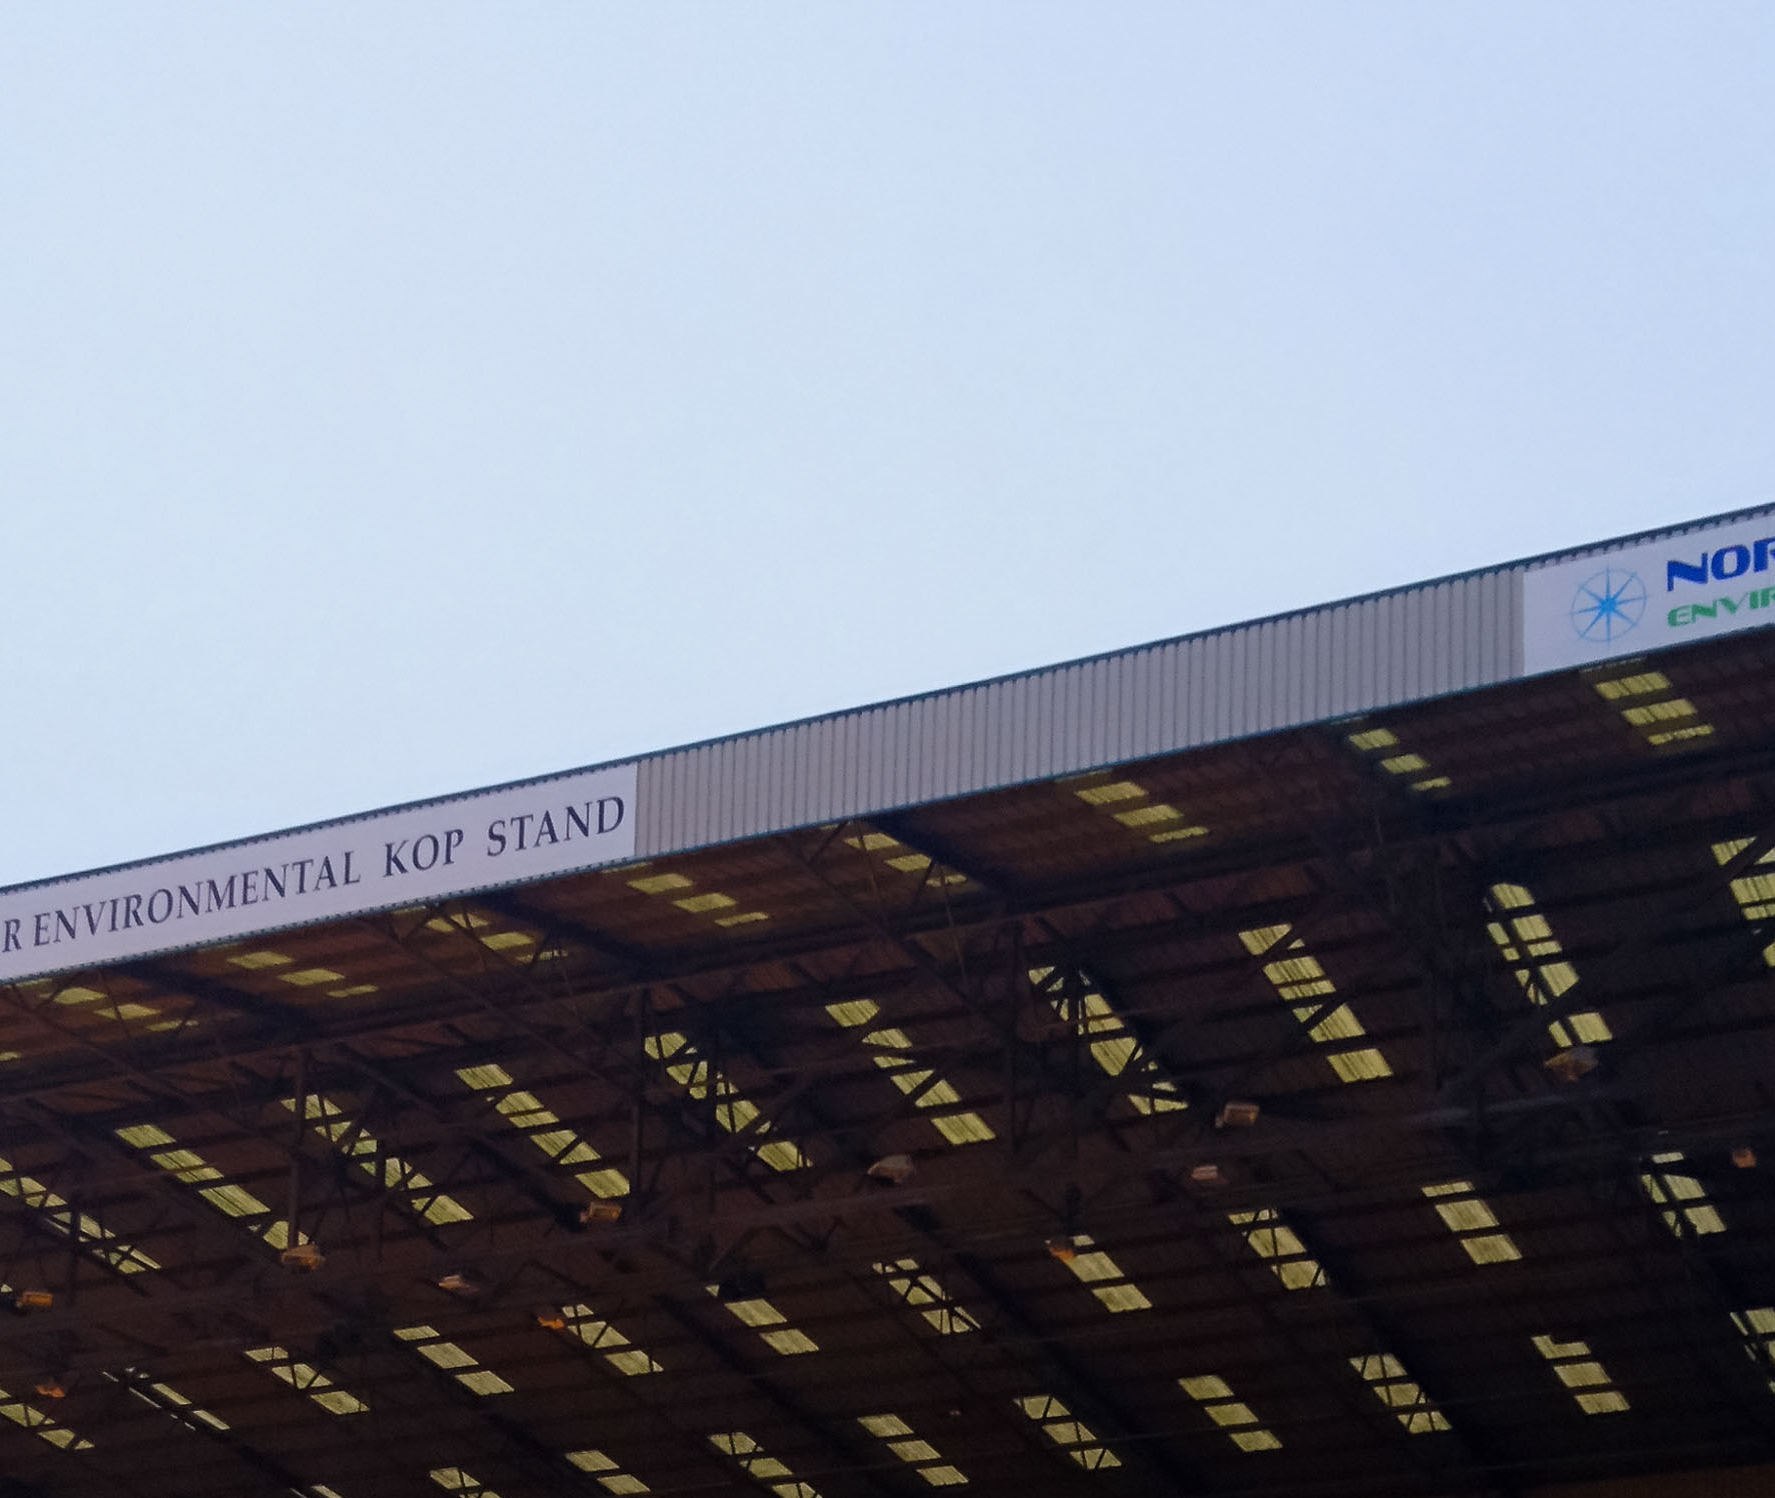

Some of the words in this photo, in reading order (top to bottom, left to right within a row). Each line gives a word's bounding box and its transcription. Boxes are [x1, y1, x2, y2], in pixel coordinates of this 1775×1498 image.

[33, 850, 360, 946] ENVIRONMENTAL
[384, 829, 464, 877] KOP
[487, 796, 624, 857] STAND
